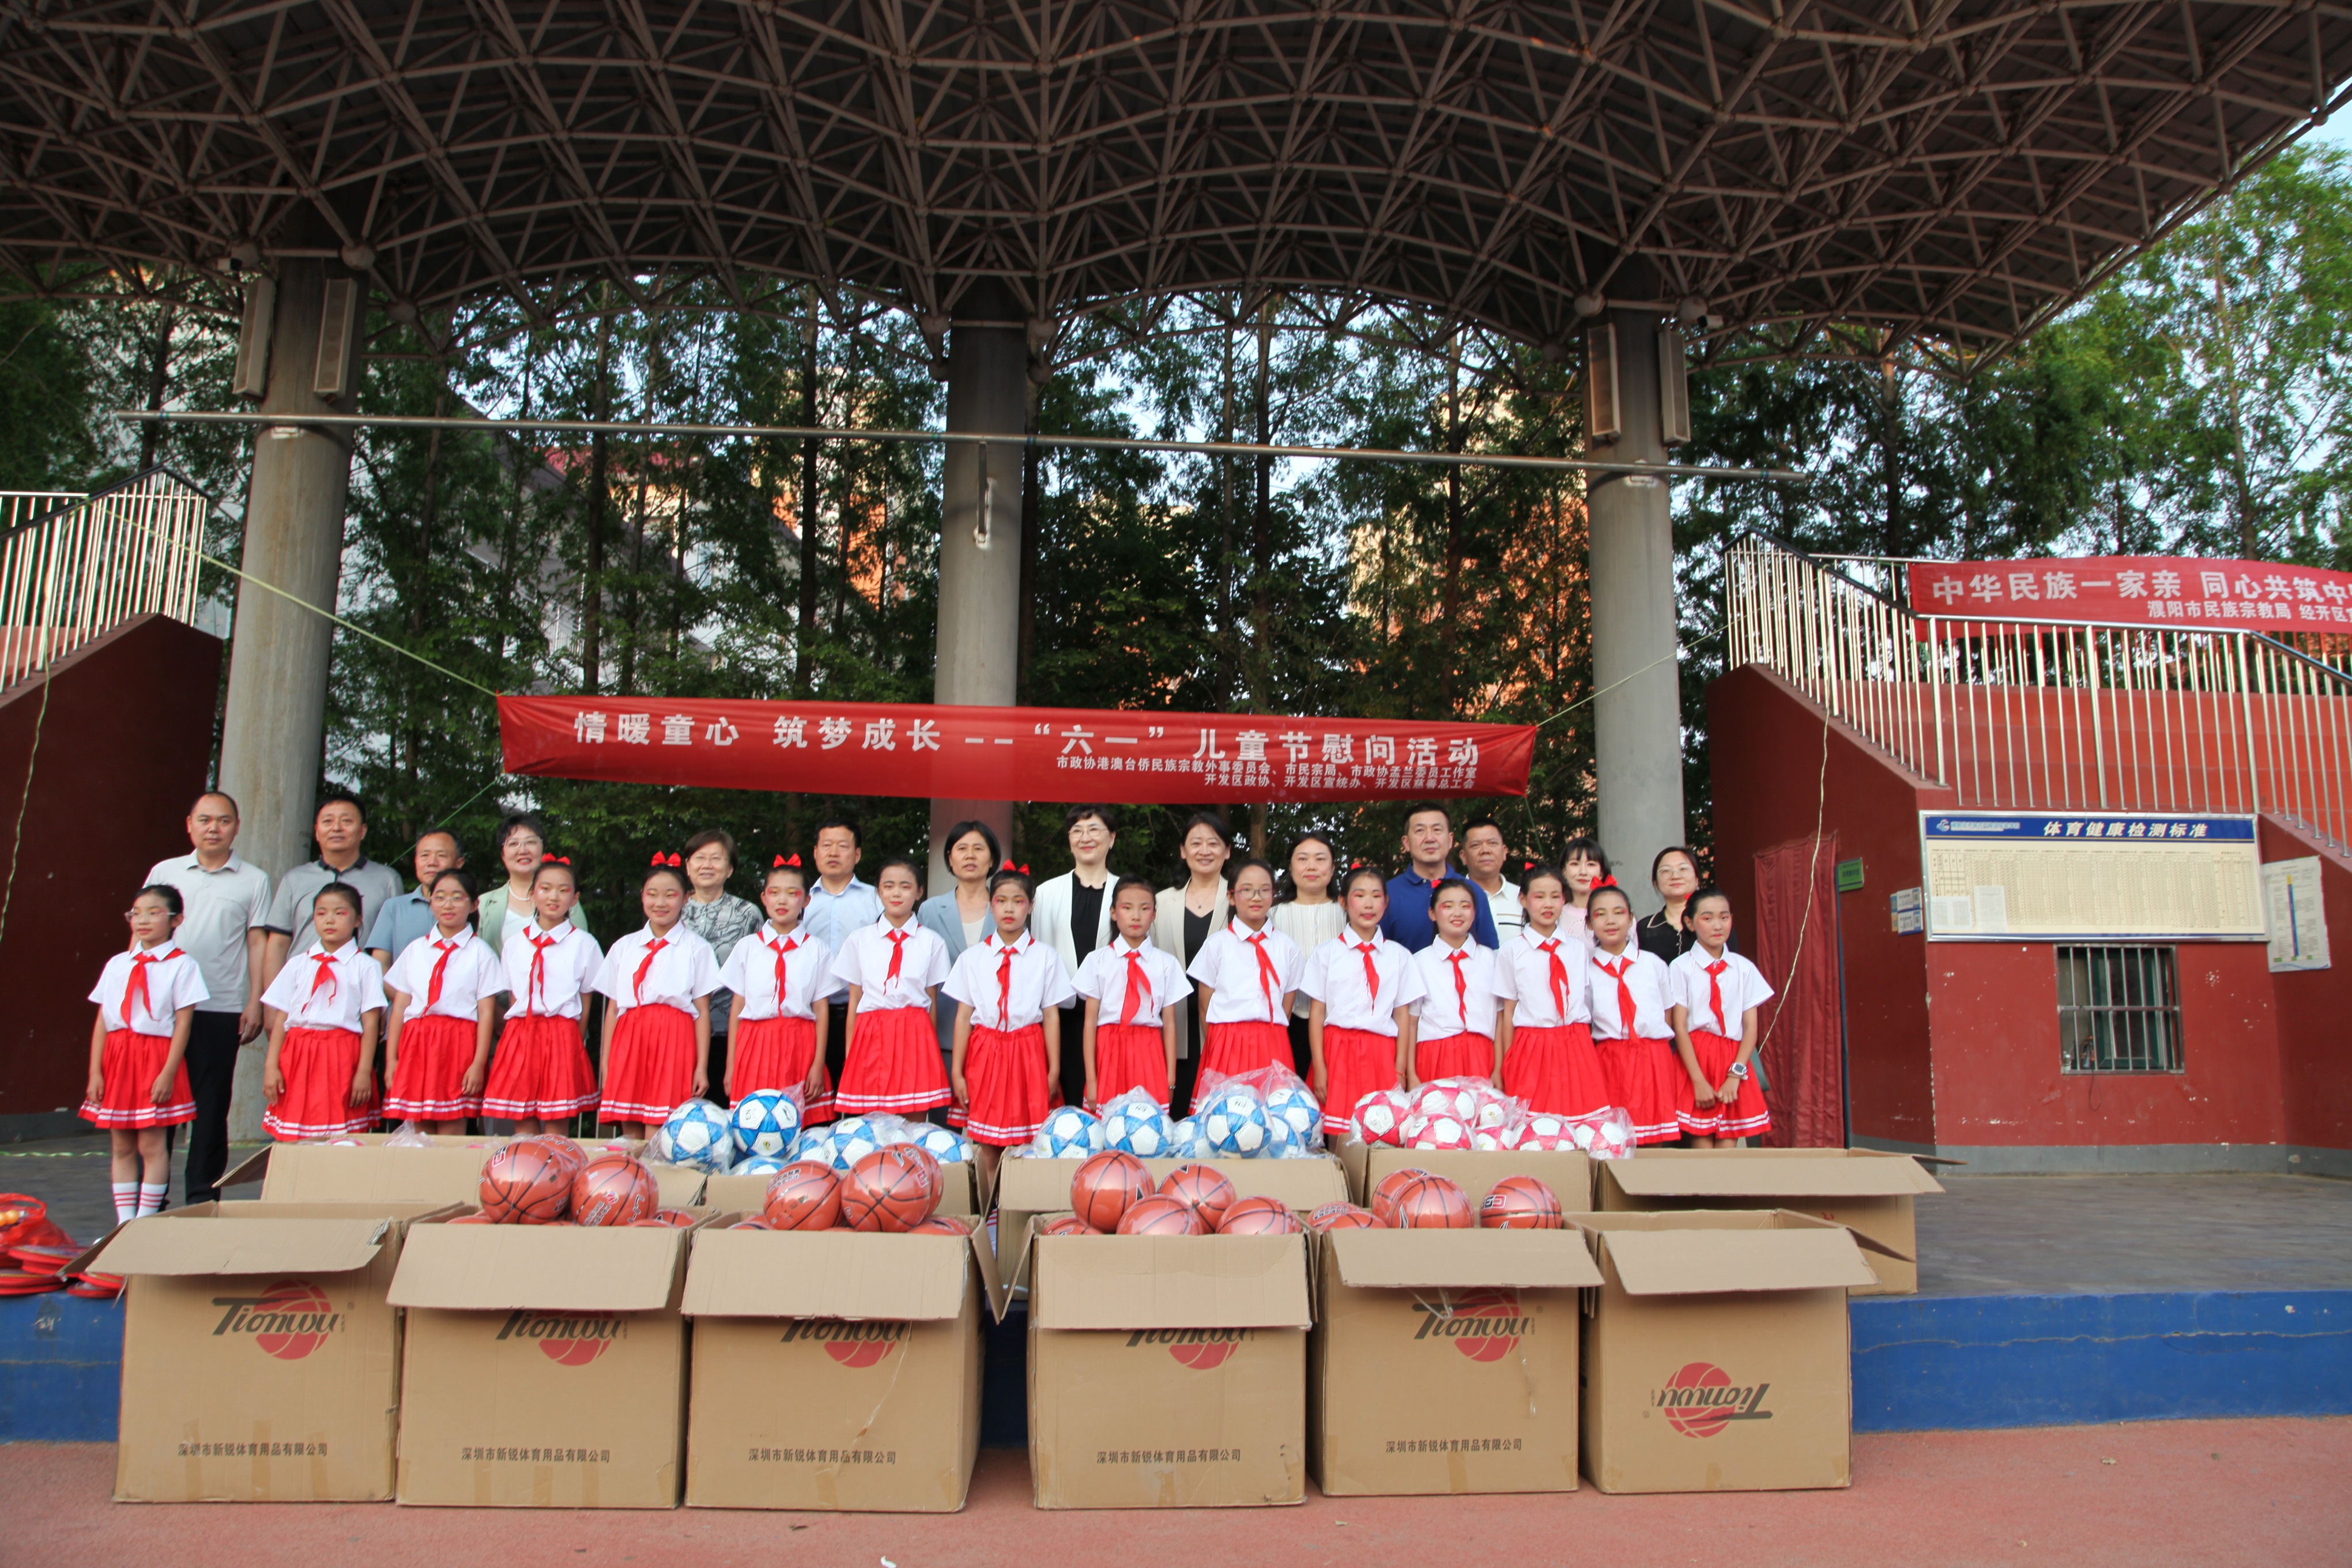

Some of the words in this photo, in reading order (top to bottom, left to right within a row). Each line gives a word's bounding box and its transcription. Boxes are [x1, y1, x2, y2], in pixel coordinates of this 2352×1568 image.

[1932, 570, 2181, 605] 中华民族一家亲
[2200, 571, 2352, 605] 同心共筑中
[2147, 600, 2292, 620] 濮阳市民族宗教局
[574, 711, 740, 747] 情暖童心
[2043, 821, 2208, 838] 体育健康检测标准
[212, 1296, 340, 1336] Tionwu
[178, 1442, 328, 1457] 深圳市新锐体育用品有限公司
[1385, 1438, 1522, 1454] 深圳市新锐体育用品有限公司
[462, 1447, 610, 1463] 深圳市新锐体育用品有限公司
[1096, 1448, 1241, 1464] 深圳市新锐体育用品有限公司
